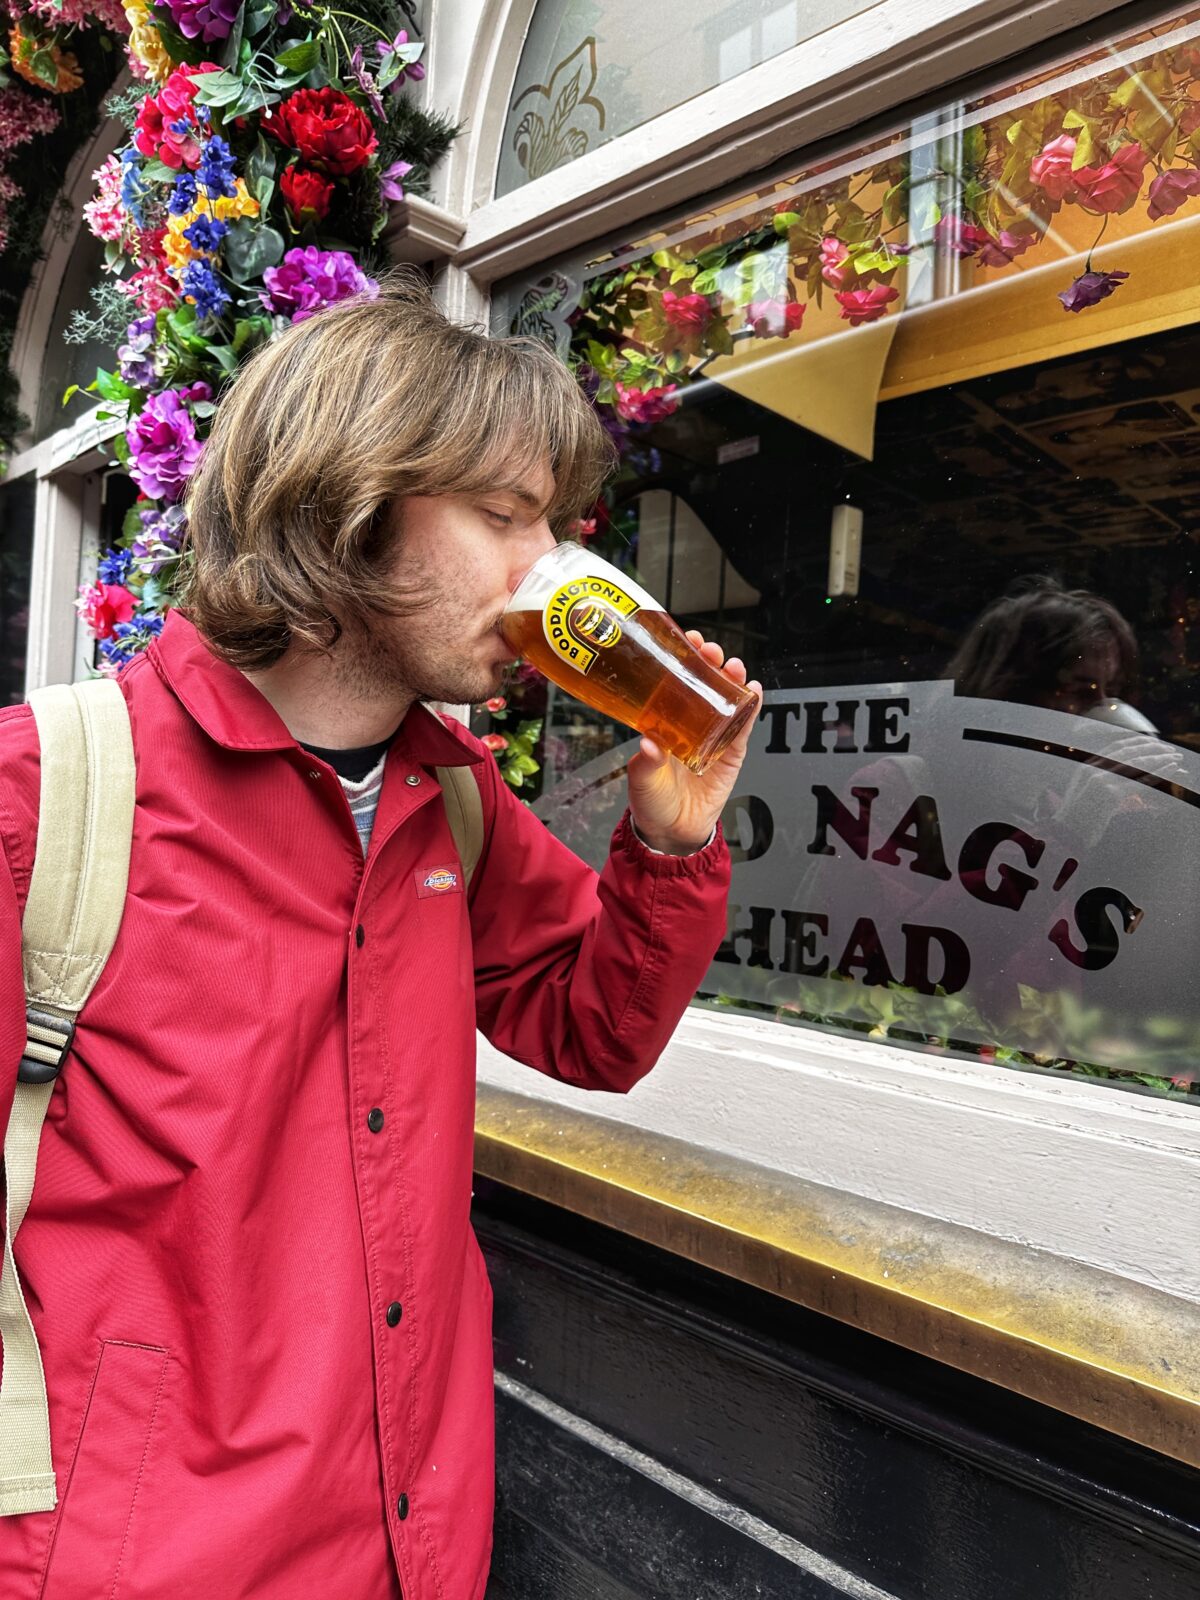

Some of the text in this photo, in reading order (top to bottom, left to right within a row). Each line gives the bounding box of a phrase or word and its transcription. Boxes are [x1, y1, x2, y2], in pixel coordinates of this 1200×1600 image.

[550, 581, 623, 659] BODDINGTONS
[759, 697, 910, 754] THE
[806, 784, 1145, 971] NAG'S
[714, 904, 971, 994] HEAD
